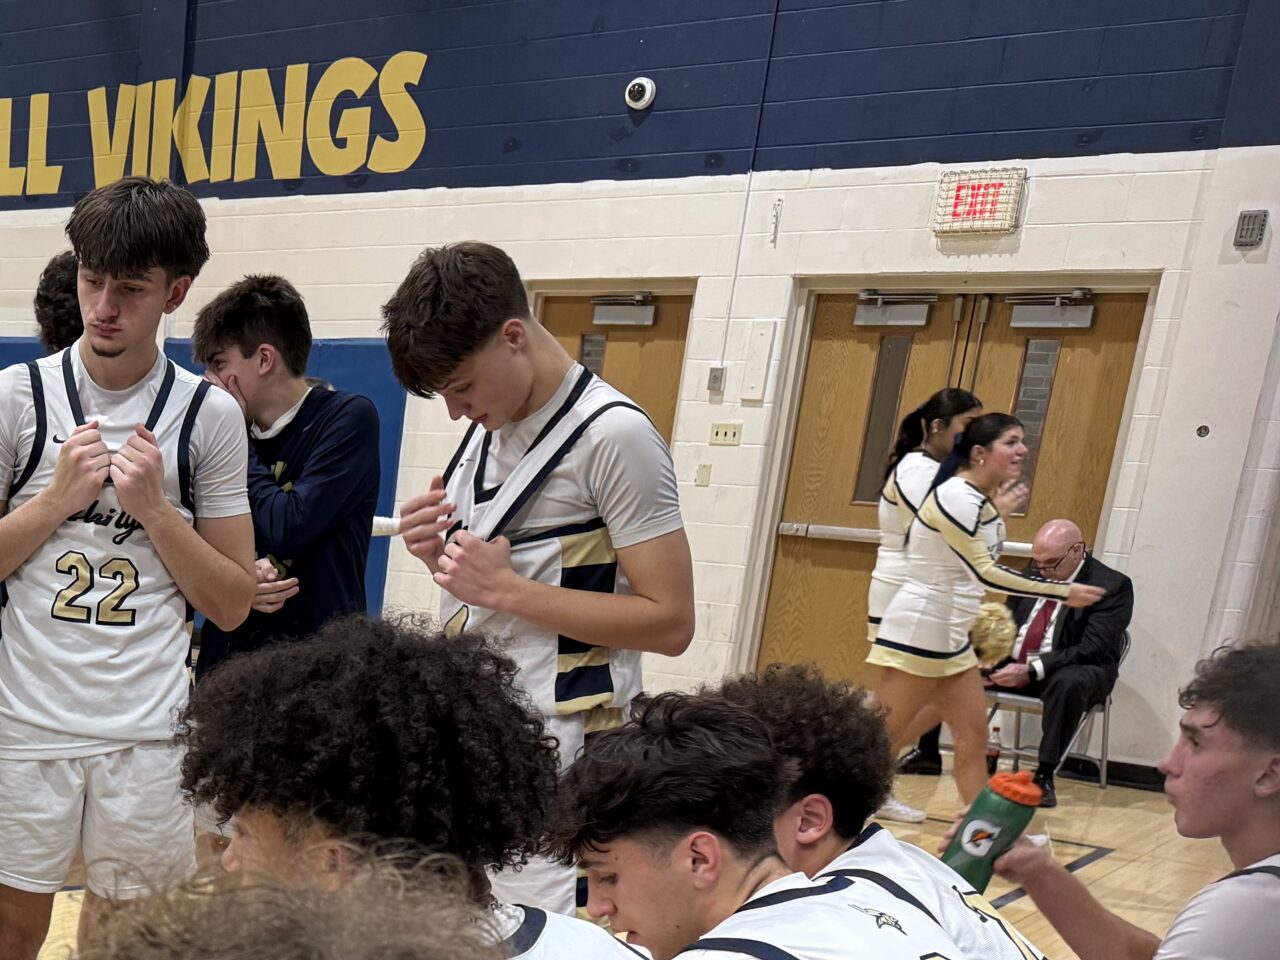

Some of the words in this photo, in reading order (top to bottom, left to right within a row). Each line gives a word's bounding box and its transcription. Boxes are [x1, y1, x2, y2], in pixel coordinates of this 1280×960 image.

[87, 51, 428, 184] VIKINGS
[952, 182, 1005, 218] EXIT
[51, 550, 140, 626] 22
